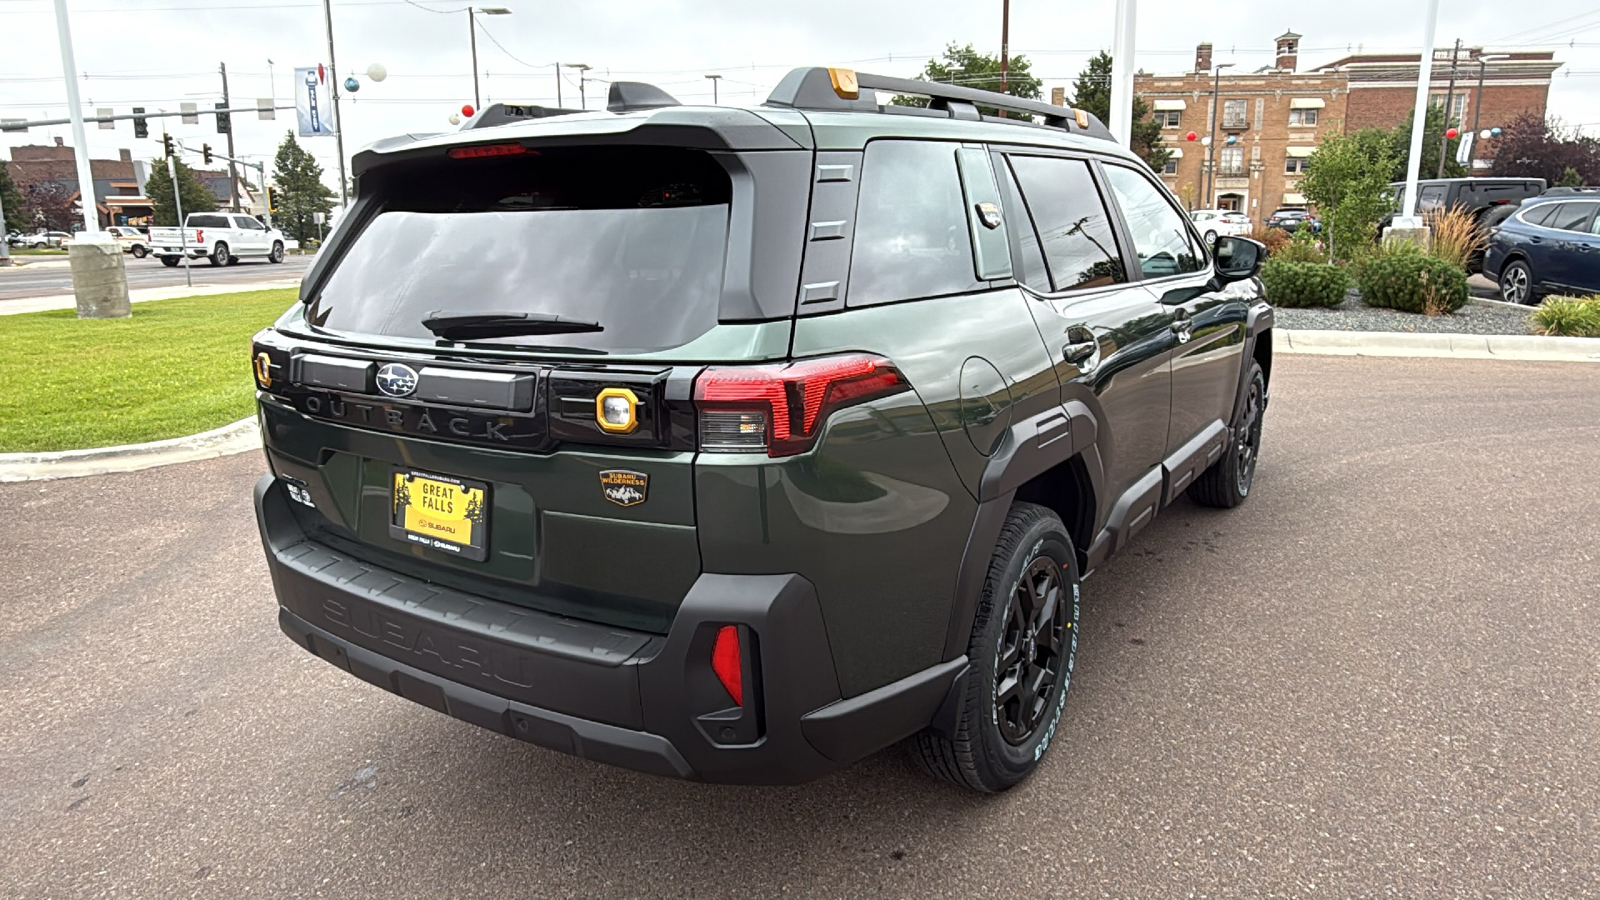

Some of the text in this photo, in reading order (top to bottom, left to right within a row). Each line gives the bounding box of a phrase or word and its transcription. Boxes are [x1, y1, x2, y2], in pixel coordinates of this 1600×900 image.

[306, 396, 509, 441] OUTBACK
[602, 477, 645, 486] WILDERNESS
[609, 472, 637, 480] SUBARU
[422, 483, 454, 500] GREAT
[422, 496, 454, 514] FALLS
[427, 522, 456, 534] SUBARU
[321, 598, 533, 688] SUBARU
[1034, 583, 1080, 761] BRIDGESTONE
